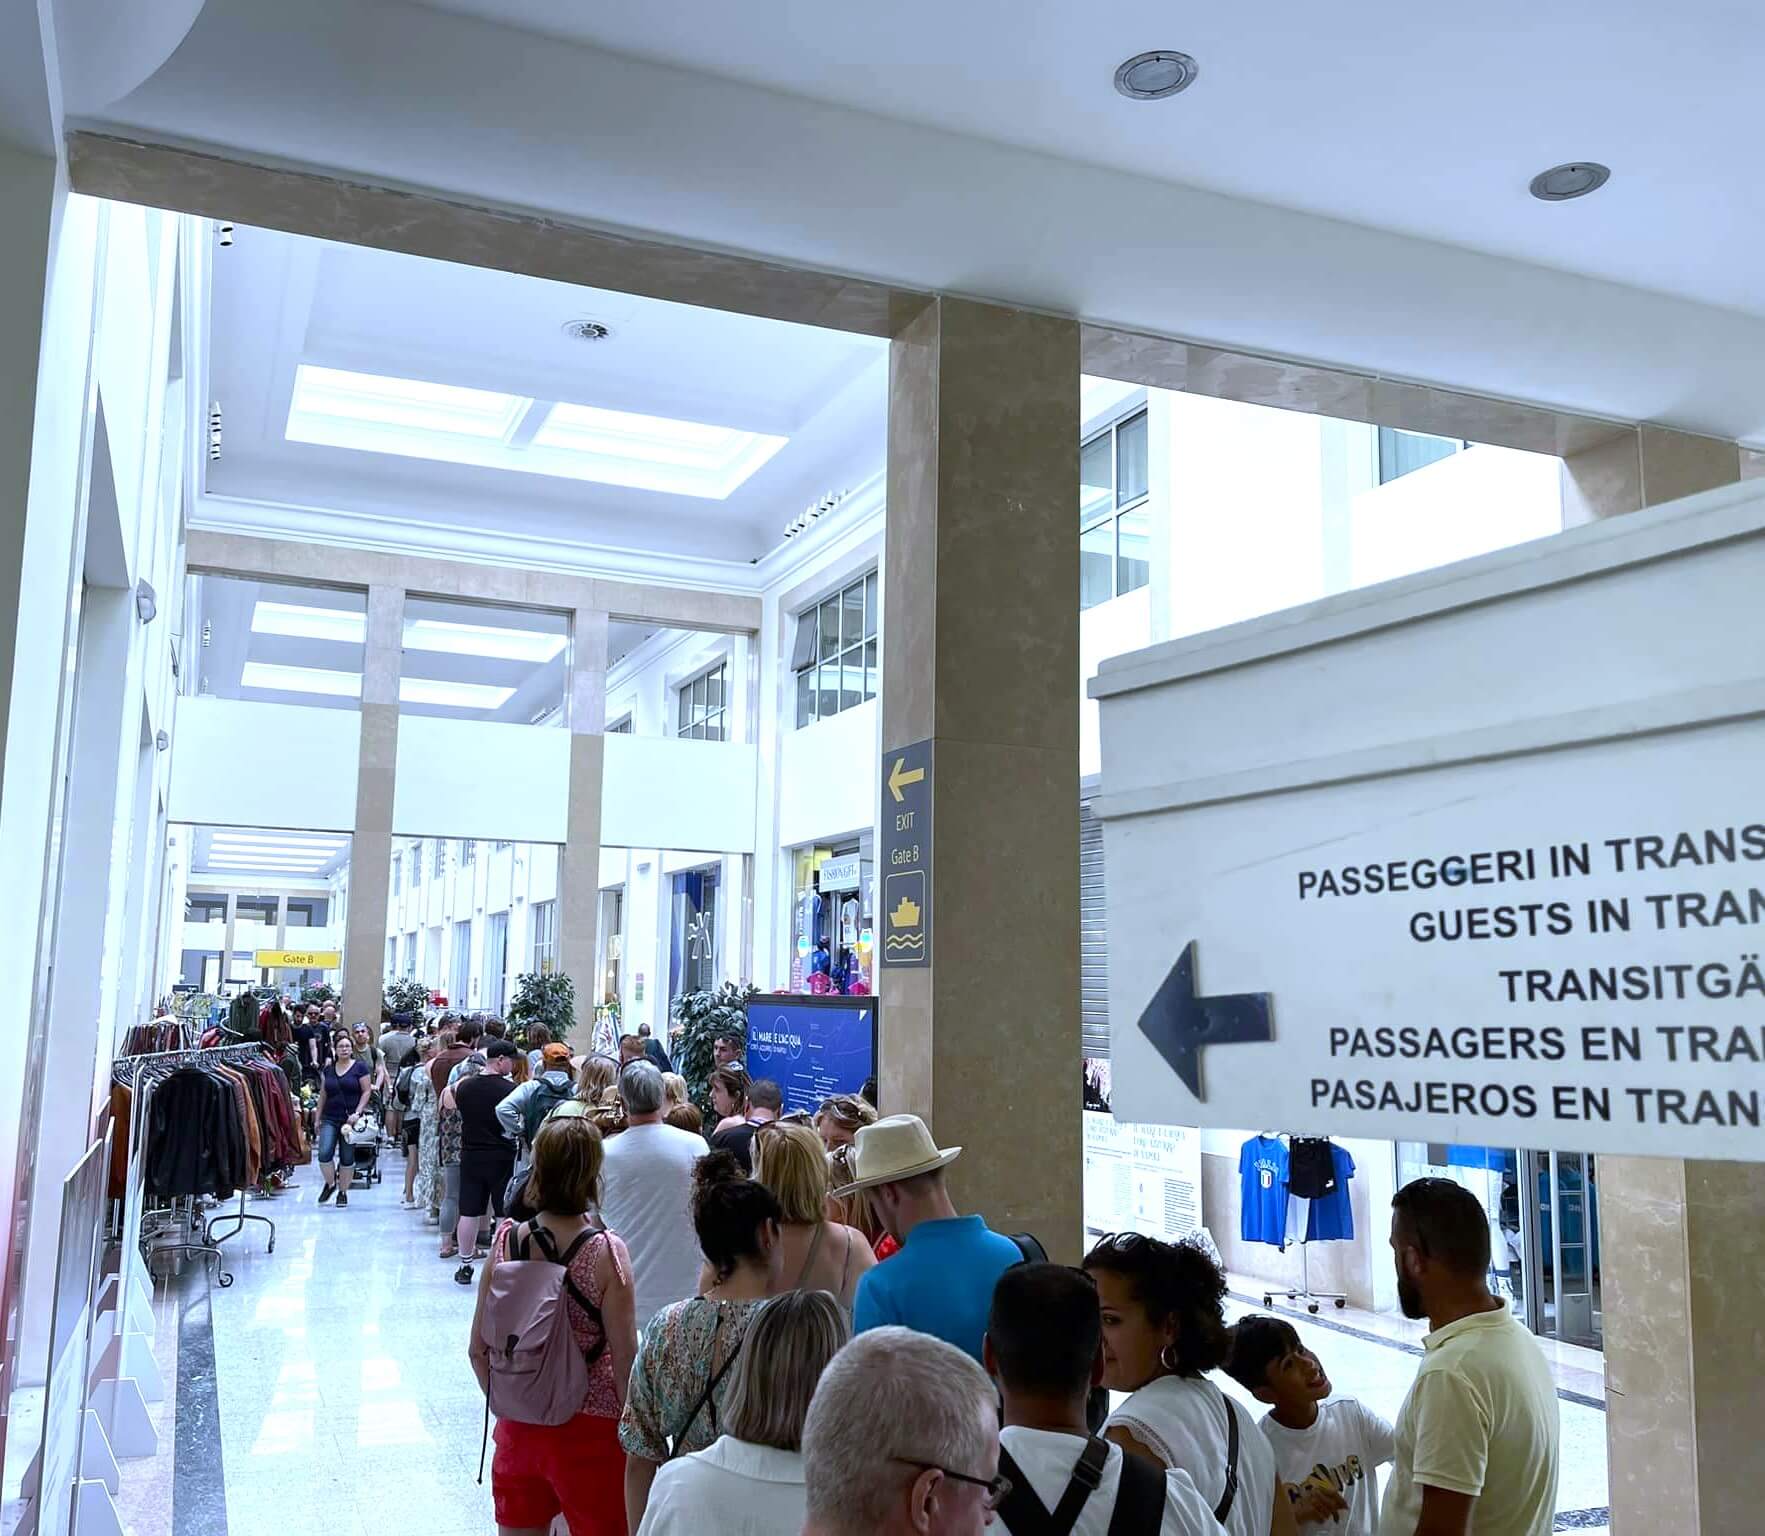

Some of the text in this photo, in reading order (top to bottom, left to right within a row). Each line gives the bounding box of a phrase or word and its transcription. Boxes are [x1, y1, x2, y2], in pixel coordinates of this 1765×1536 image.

[896, 812, 915, 831] EXIT
[892, 844, 919, 865] Gate B
[1299, 824, 1765, 900] PASSEGGERI IN TRANS
[1409, 902, 1572, 943] GUESTS
[1588, 897, 1630, 933] IN
[283, 954, 314, 964] Gate B
[1498, 954, 1765, 1002] TRANSITGÄ
[1330, 1026, 1765, 1062] PASSAGERS EN TRA
[1311, 1079, 1765, 1127] PASAJEROS EN TRAN
